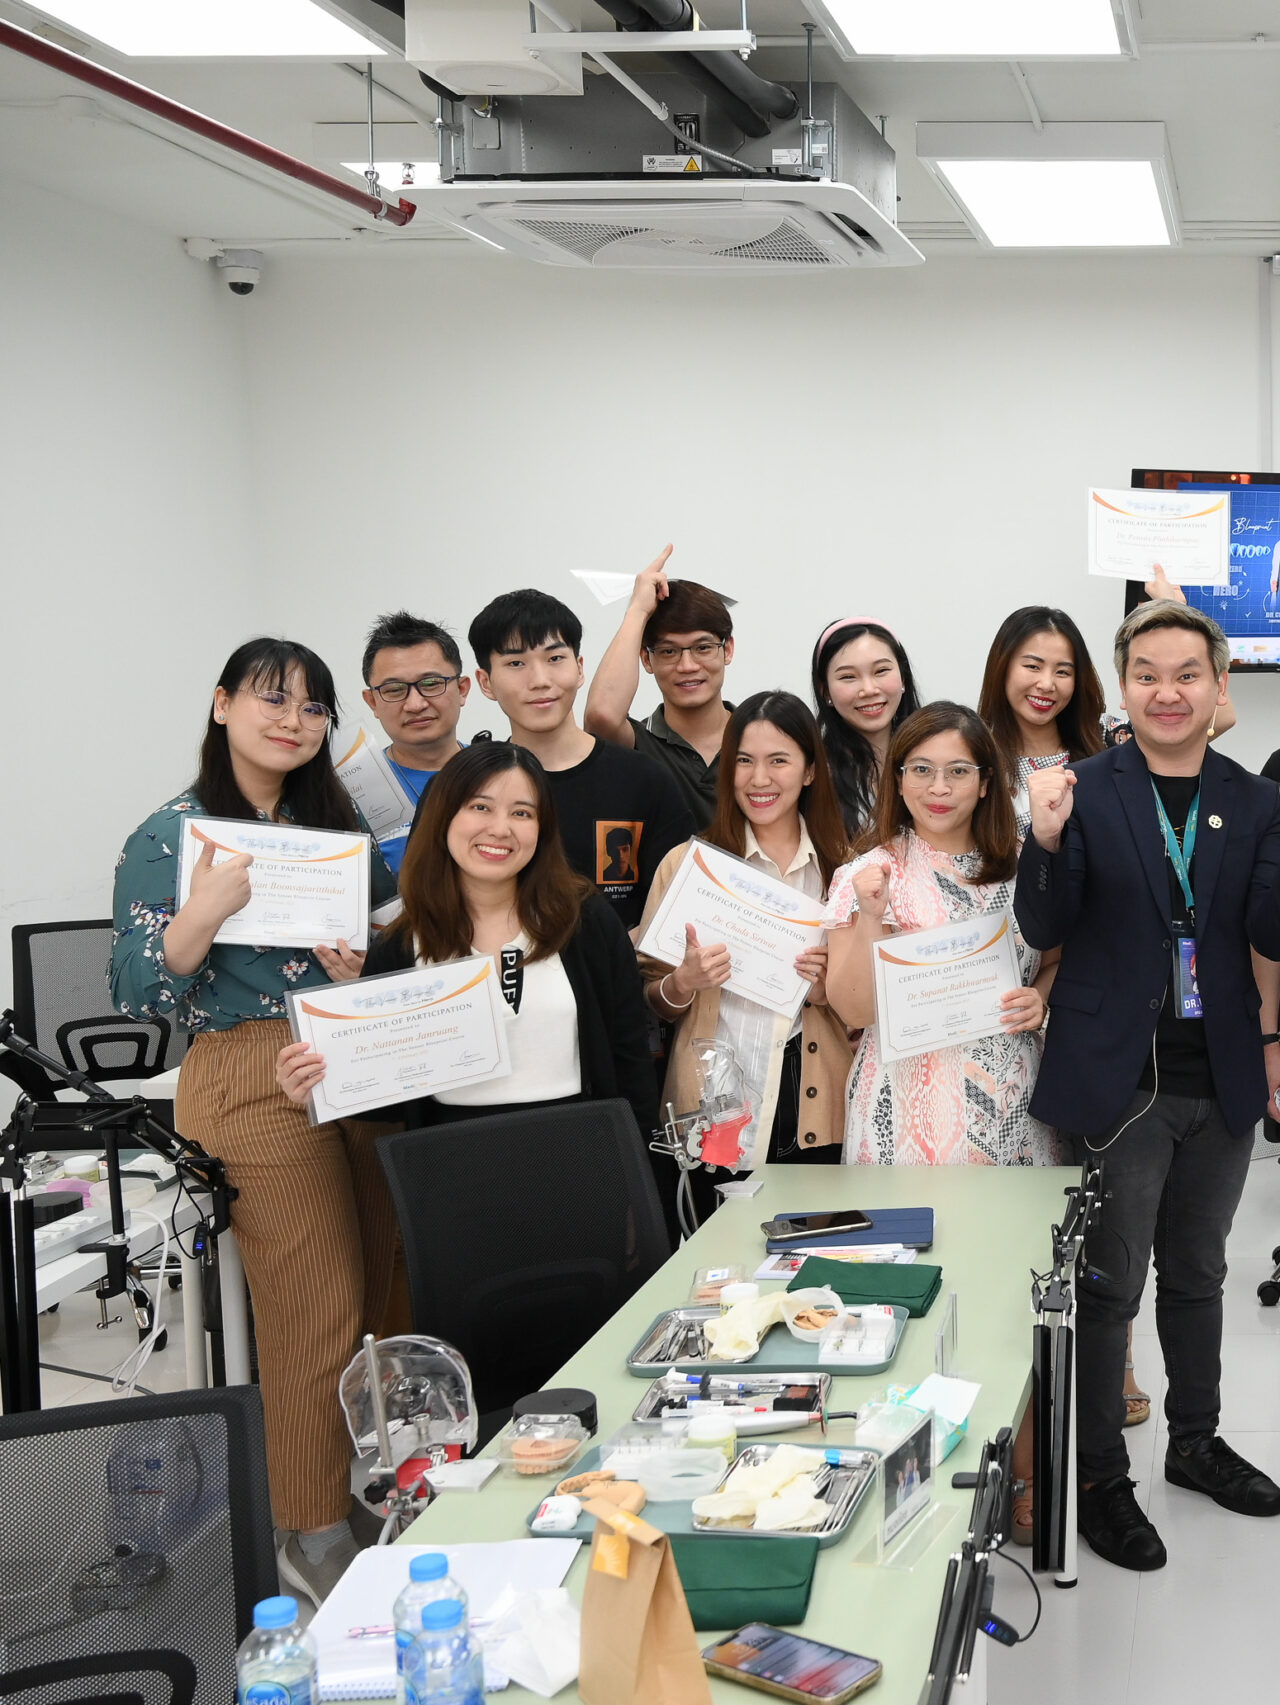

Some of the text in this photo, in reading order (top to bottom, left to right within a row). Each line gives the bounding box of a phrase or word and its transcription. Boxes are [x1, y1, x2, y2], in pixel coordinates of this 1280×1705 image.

[280, 865, 342, 876] PARTICIPATION
[695, 886, 742, 912] CERTIFICATE
[742, 907, 753, 918] OF
[753, 912, 807, 943] PARTICIPATION
[897, 953, 1000, 985] CERTIFICATE OF PARTICIPATION
[906, 991, 917, 1002] Dr.
[330, 1001, 473, 1039] CERTIFICATE OF PARTICIPATION
[353, 1043, 368, 1055] Dr.
[370, 1033, 413, 1051] Nattanan
